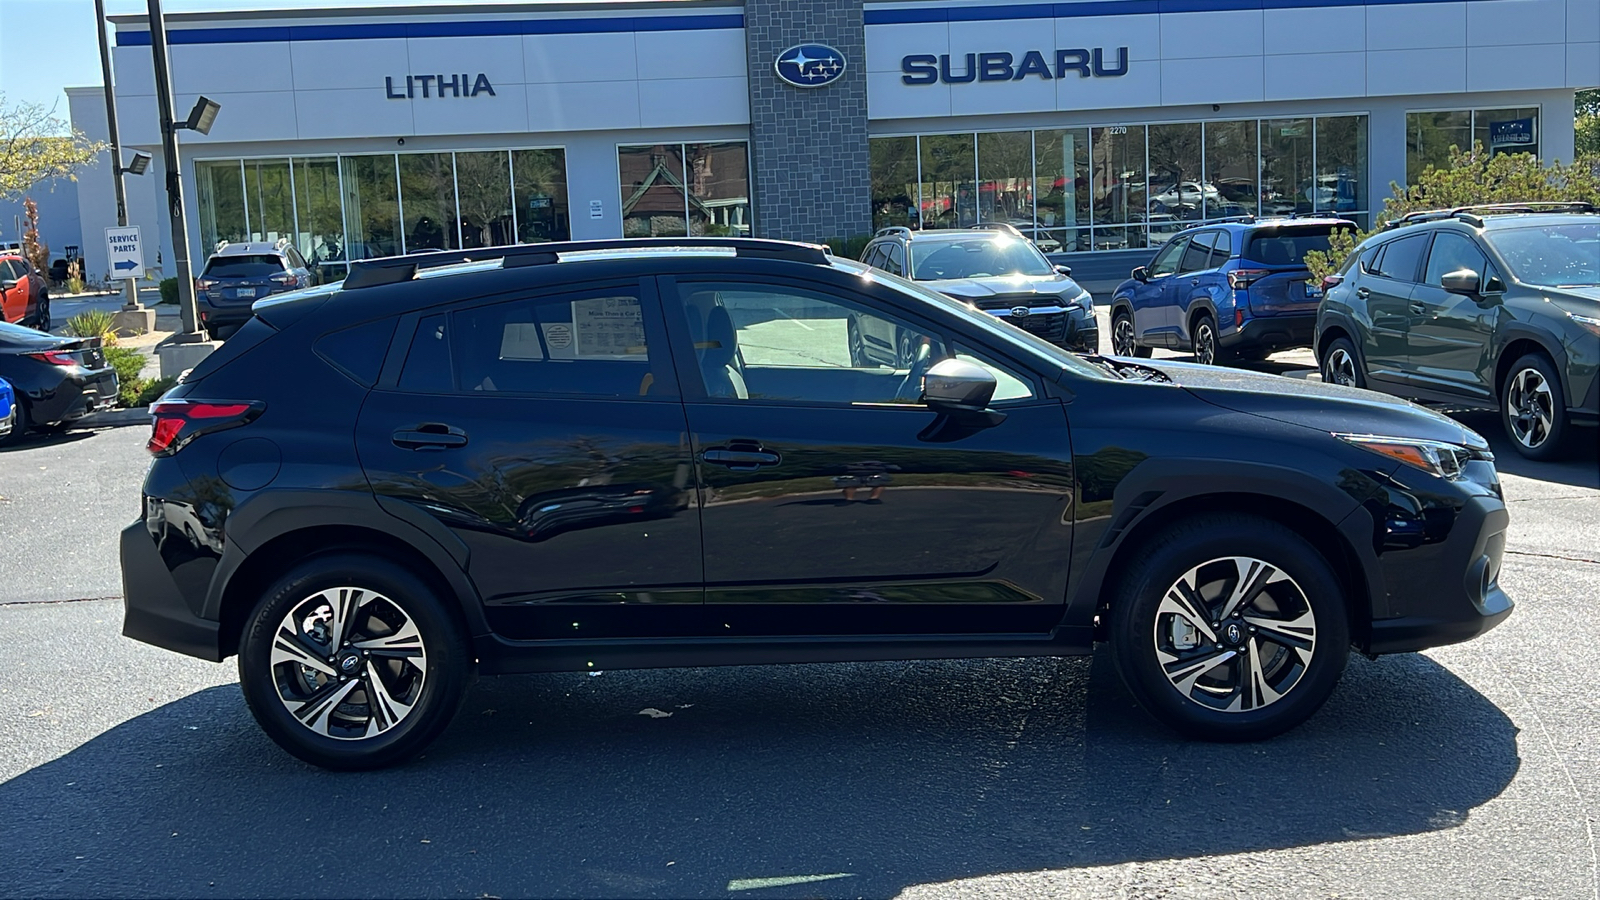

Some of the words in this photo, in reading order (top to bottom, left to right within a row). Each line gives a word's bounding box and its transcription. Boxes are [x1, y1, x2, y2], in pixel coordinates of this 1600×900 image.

[902, 47, 1128, 85] SUBARU
[385, 73, 496, 99] LITHIA
[1110, 126, 1127, 135] 2270
[109, 235, 138, 243] SERVICE
[113, 245, 136, 253] PARTS
